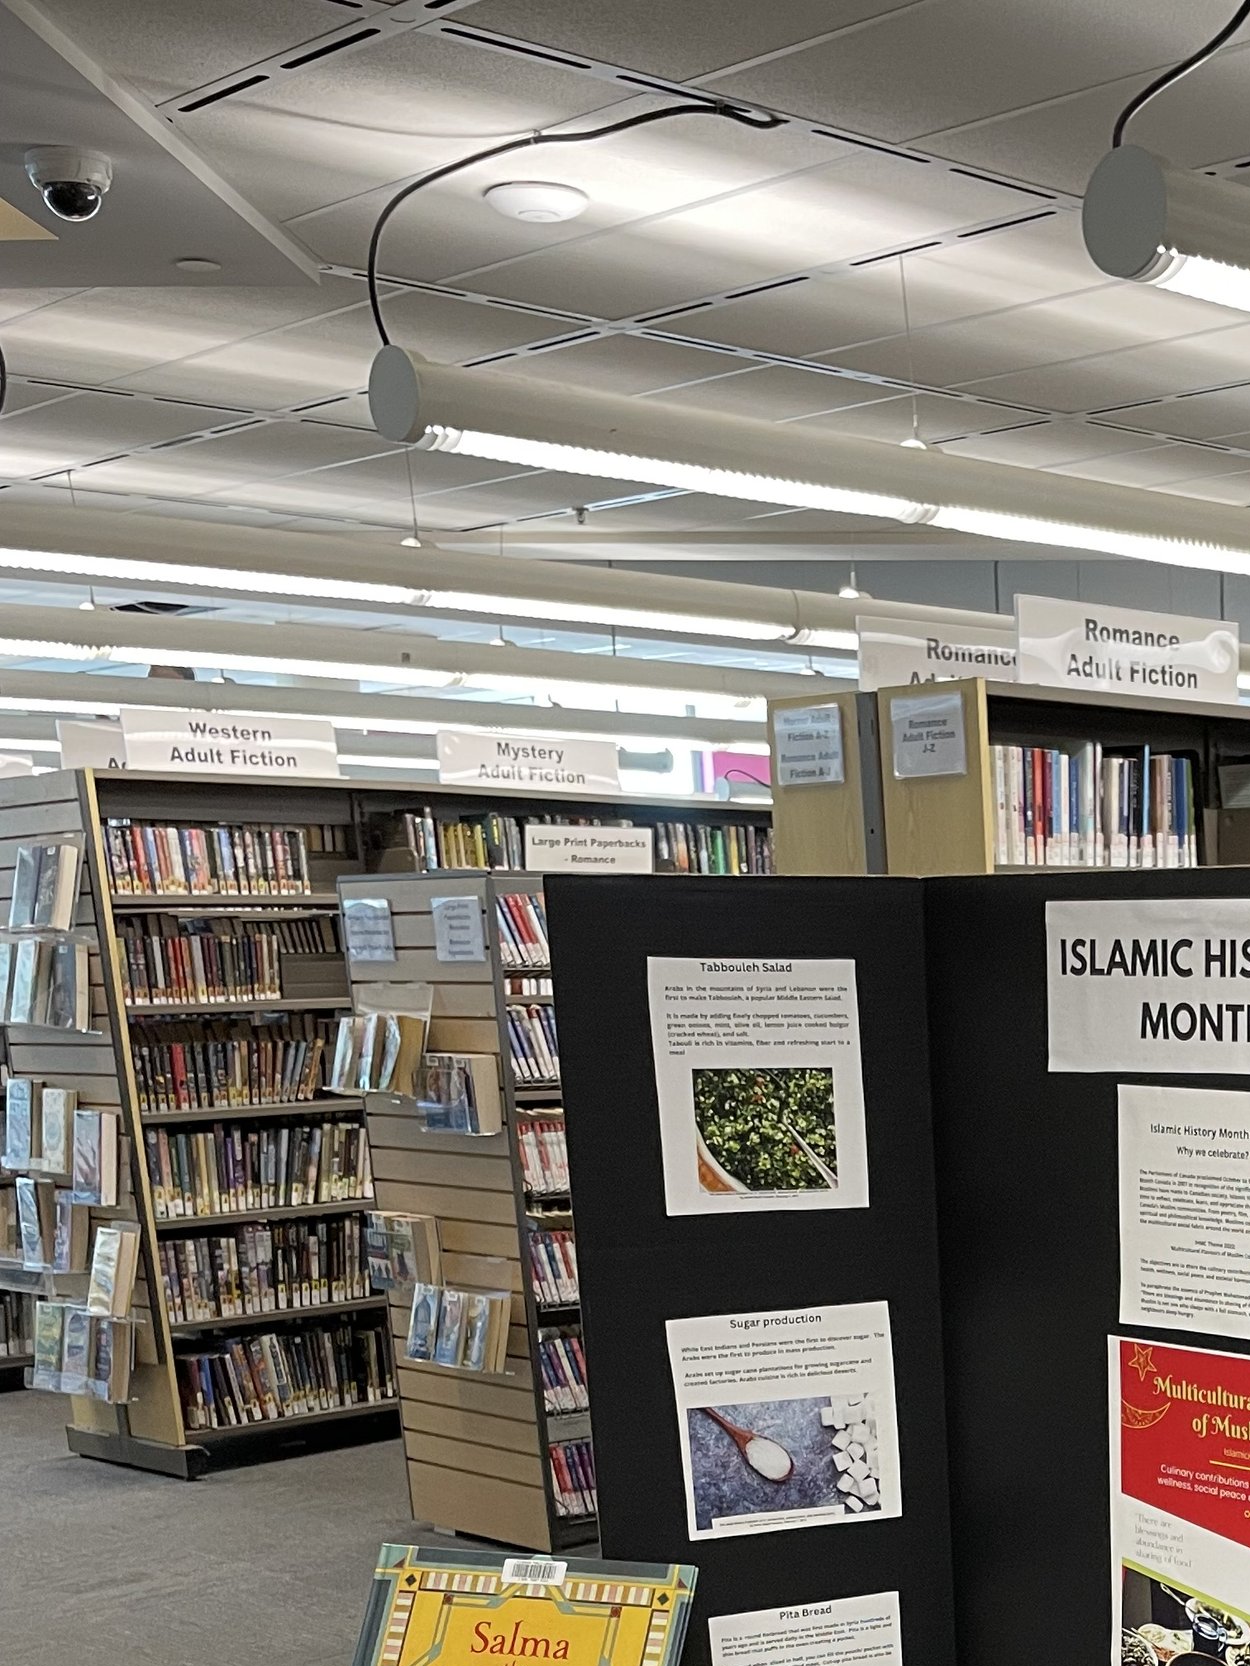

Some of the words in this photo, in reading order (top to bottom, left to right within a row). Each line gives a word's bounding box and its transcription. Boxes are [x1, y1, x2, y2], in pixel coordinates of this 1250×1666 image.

[1085, 619, 1180, 651] Romance
[1067, 654, 1122, 681] Adult
[1130, 661, 1197, 689] Fiction
[189, 722, 272, 740] Western
[909, 719, 947, 729] Romance
[903, 733, 924, 742] Adult
[926, 731, 955, 740] Fiction
[170, 747, 223, 764] Adult
[231, 750, 297, 767] Fiction
[497, 742, 564, 763] Mystery
[478, 764, 522, 780] Adult
[529, 767, 585, 784] Fiction
[532, 837, 560, 848] Large
[564, 838, 587, 846] Print
[591, 839, 646, 848] Paperbacks
[571, 855, 615, 864] Romance
[700, 962, 759, 972] Tabbouleh
[762, 963, 792, 972] Salad
[1060, 938, 1193, 978] ISLAMIC
[1151, 1123, 1181, 1135] Islamic
[1184, 1126, 1216, 1140] History
[1219, 1128, 1249, 1140] Month
[1177, 1146, 1193, 1157] Why
[1208, 1148, 1249, 1159] celebrate?
[729, 1319, 761, 1330] Sugar
[763, 1314, 822, 1329] production
[1192, 1416, 1208, 1438] of
[1160, 1464, 1193, 1480] Culinary
[1195, 1470, 1249, 1490] contributions
[1158, 1476, 1192, 1491] wellness,
[1194, 1481, 1218, 1496] social
[1220, 1488, 1246, 1502] peace
[779, 1610, 799, 1620] Pita
[802, 1605, 832, 1618] Bread
[471, 1620, 569, 1660] Salma
